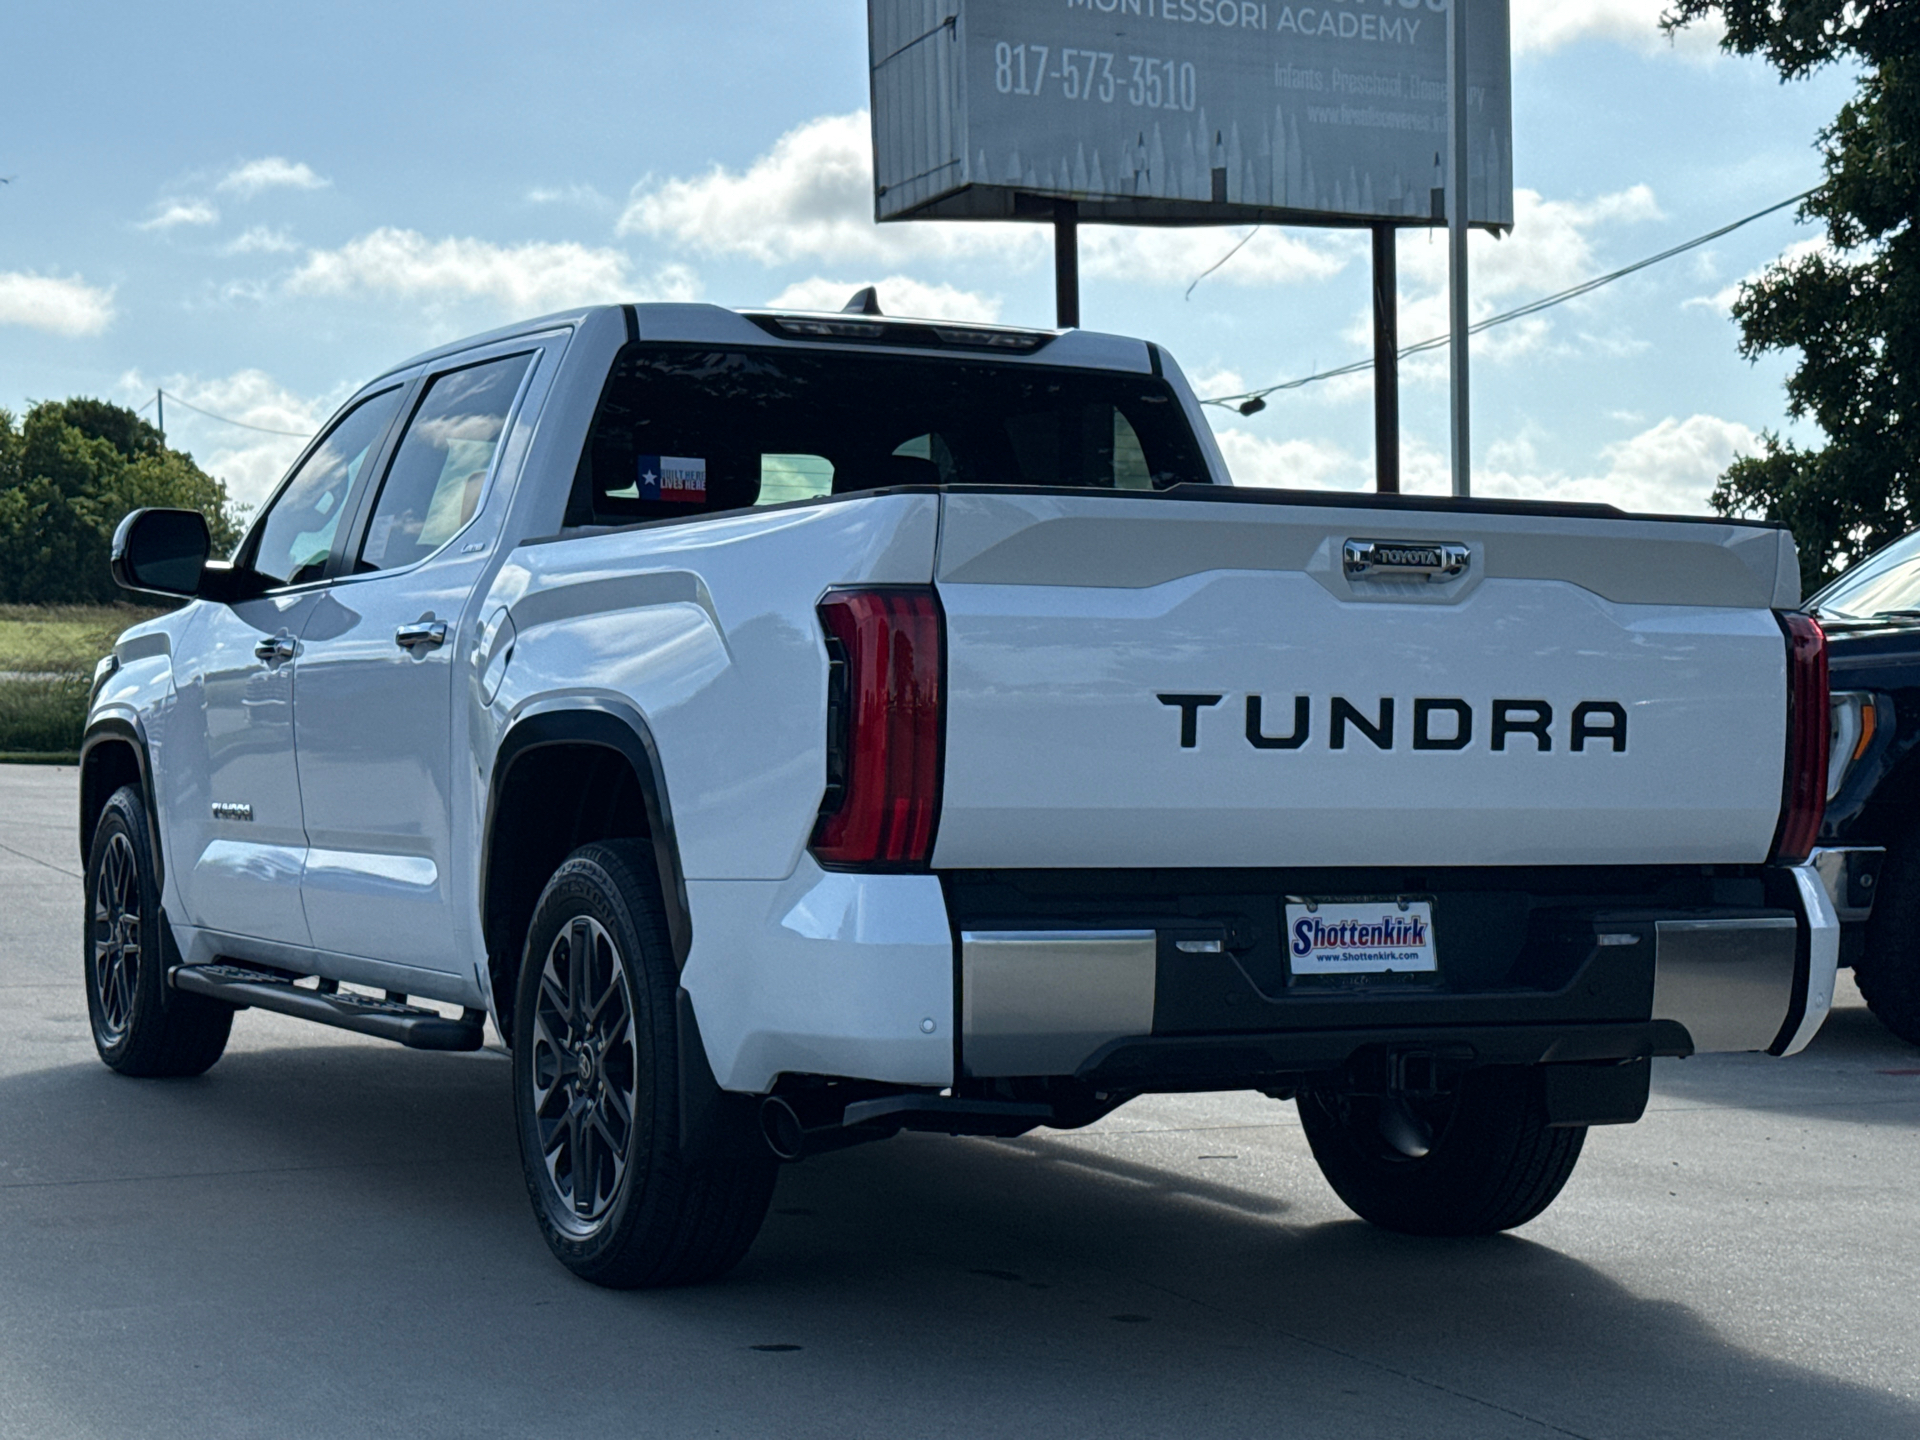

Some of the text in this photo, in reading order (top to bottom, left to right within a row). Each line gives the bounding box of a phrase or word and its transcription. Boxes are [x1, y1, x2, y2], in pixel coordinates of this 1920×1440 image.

[1277, 6, 1420, 44] ACADEMY
[995, 41, 1196, 112] 817-573-3510
[660, 469, 683, 480] BUILT
[660, 478, 706, 491] LIVES HERE
[1380, 549, 1438, 565] TOYOTA
[1157, 694, 1627, 752] TUNDRA
[1292, 916, 1426, 956] Shottenkirk
[1316, 951, 1419, 962] www.Shottenkirk.com
